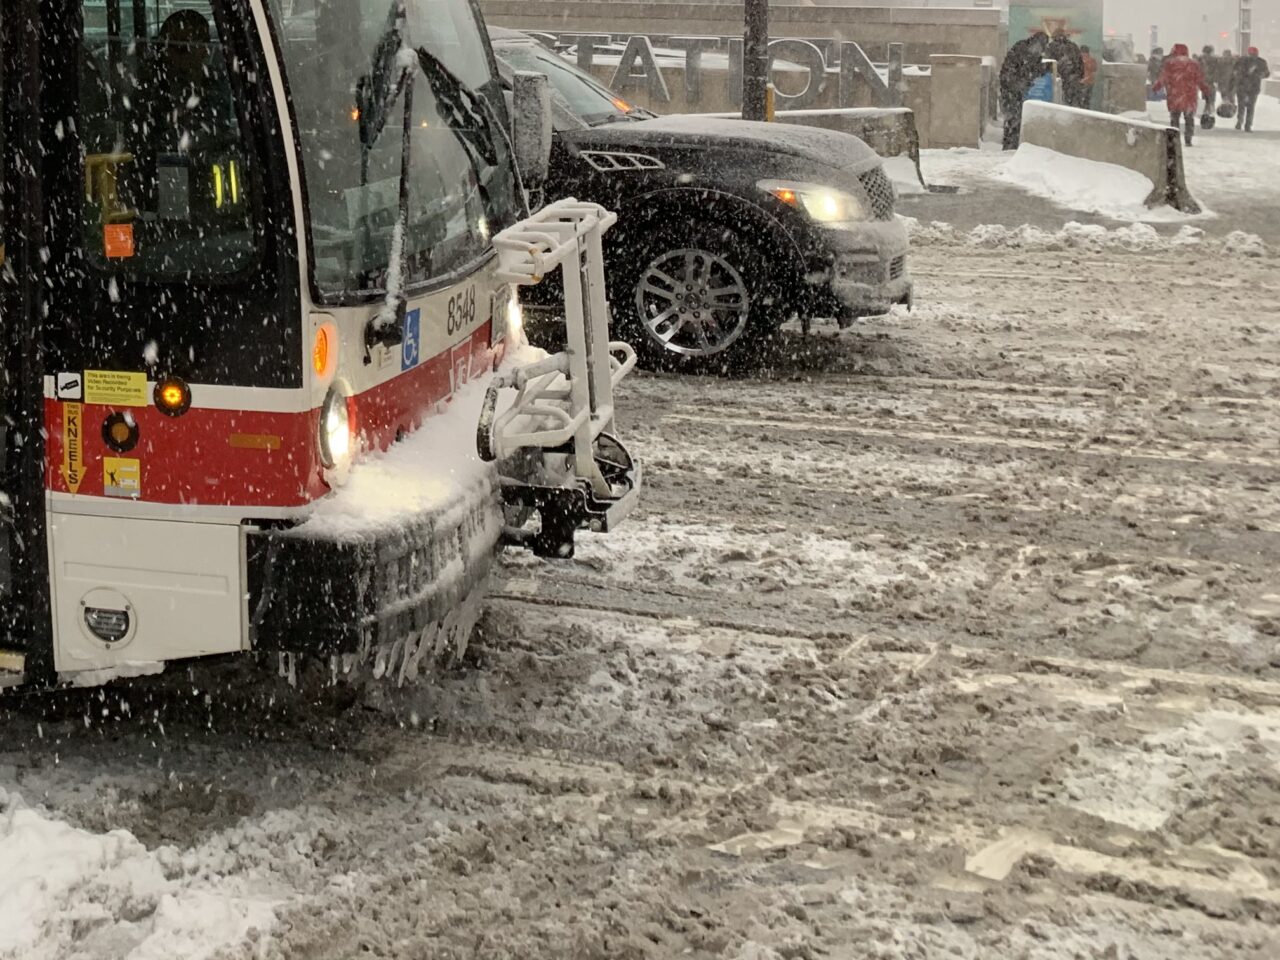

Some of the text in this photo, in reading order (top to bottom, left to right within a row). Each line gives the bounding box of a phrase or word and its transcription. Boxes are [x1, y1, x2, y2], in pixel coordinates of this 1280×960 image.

[528, 31, 903, 108] TATION
[447, 284, 476, 336] 8548
[67, 416, 78, 484] KNEELS
